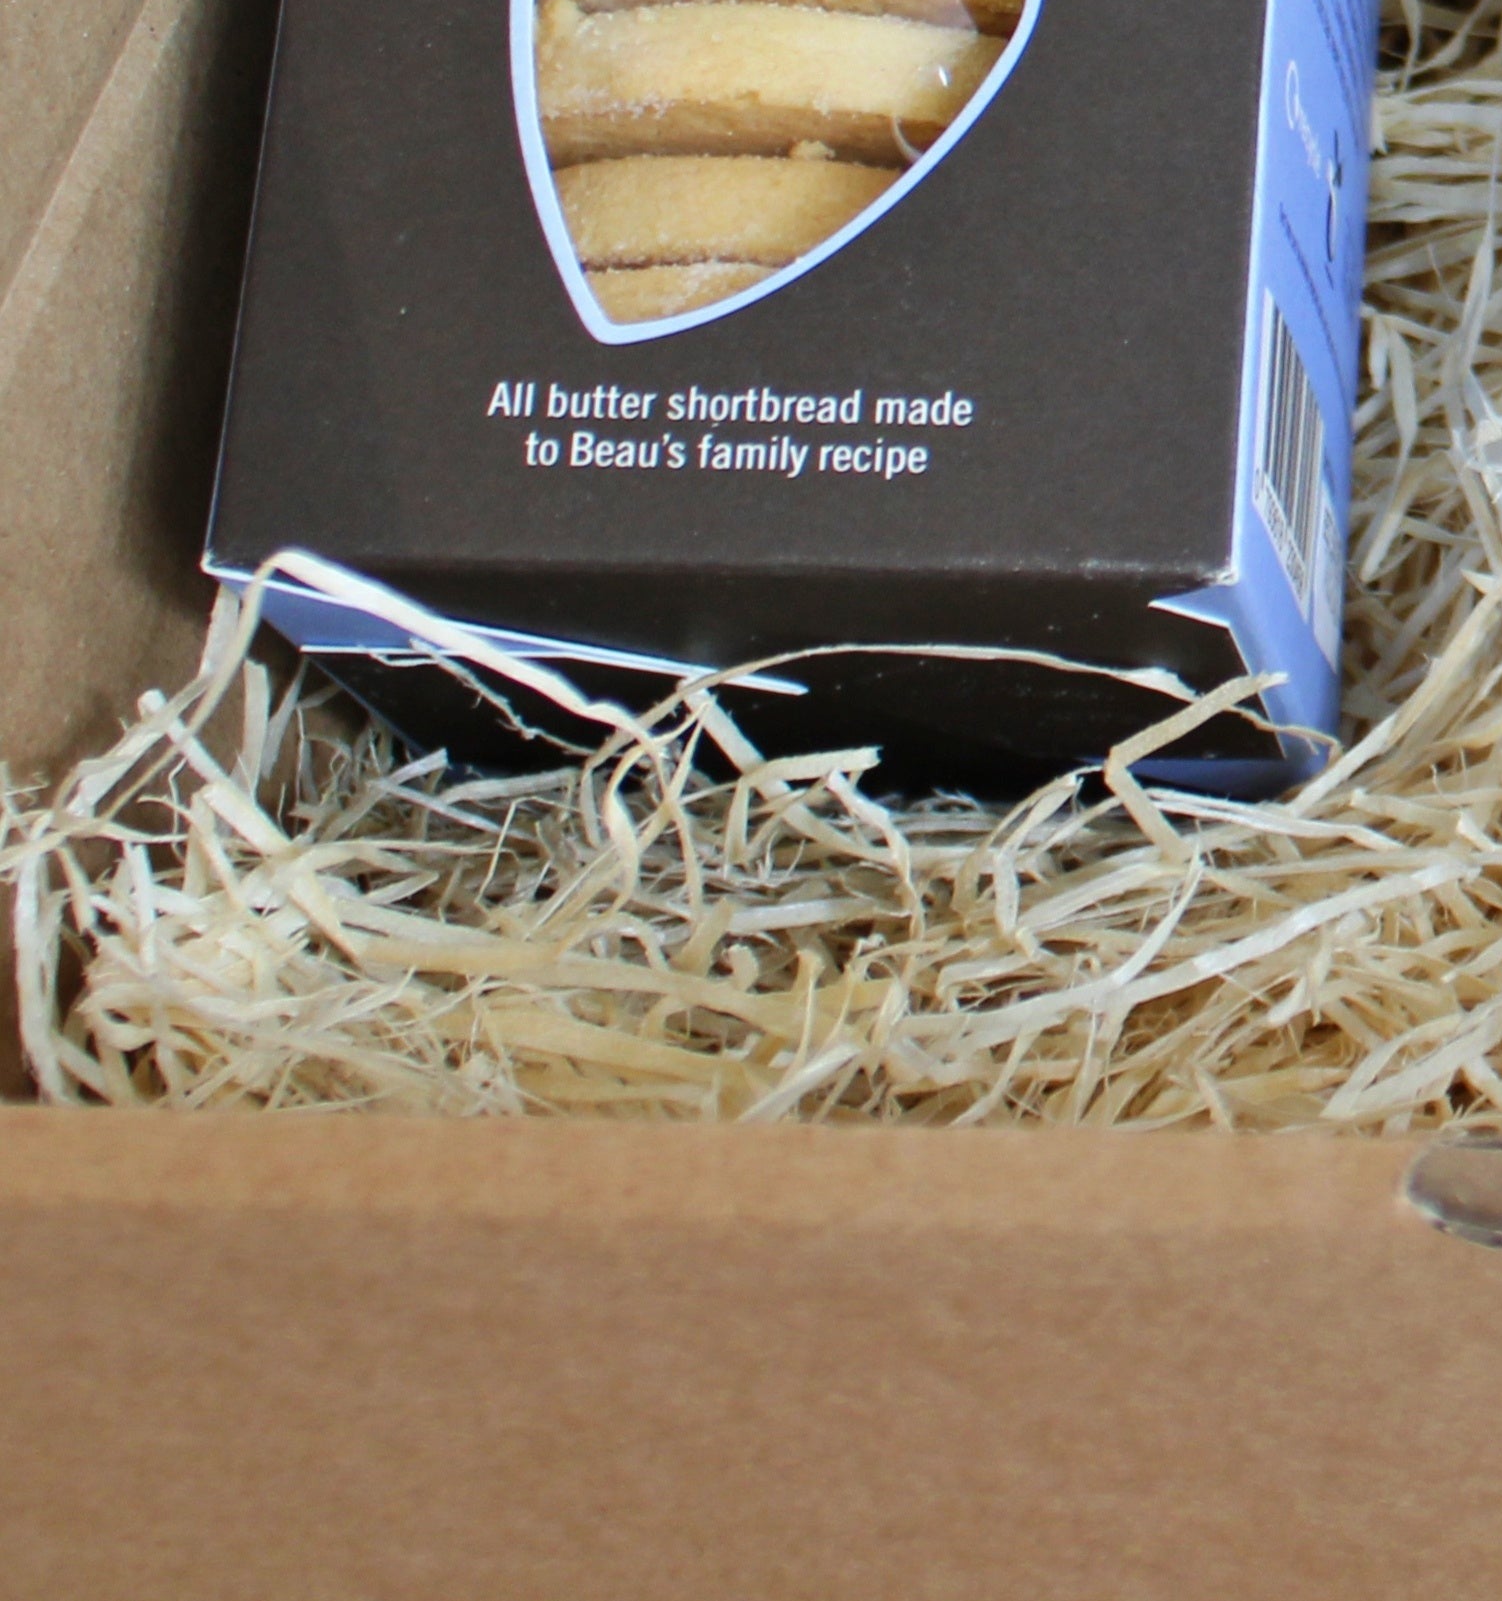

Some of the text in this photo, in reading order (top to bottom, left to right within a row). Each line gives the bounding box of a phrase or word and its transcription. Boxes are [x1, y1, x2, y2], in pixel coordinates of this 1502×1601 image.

[486, 381, 974, 426] All butter shortbread made
[524, 430, 929, 481] to Beau's family recipe
